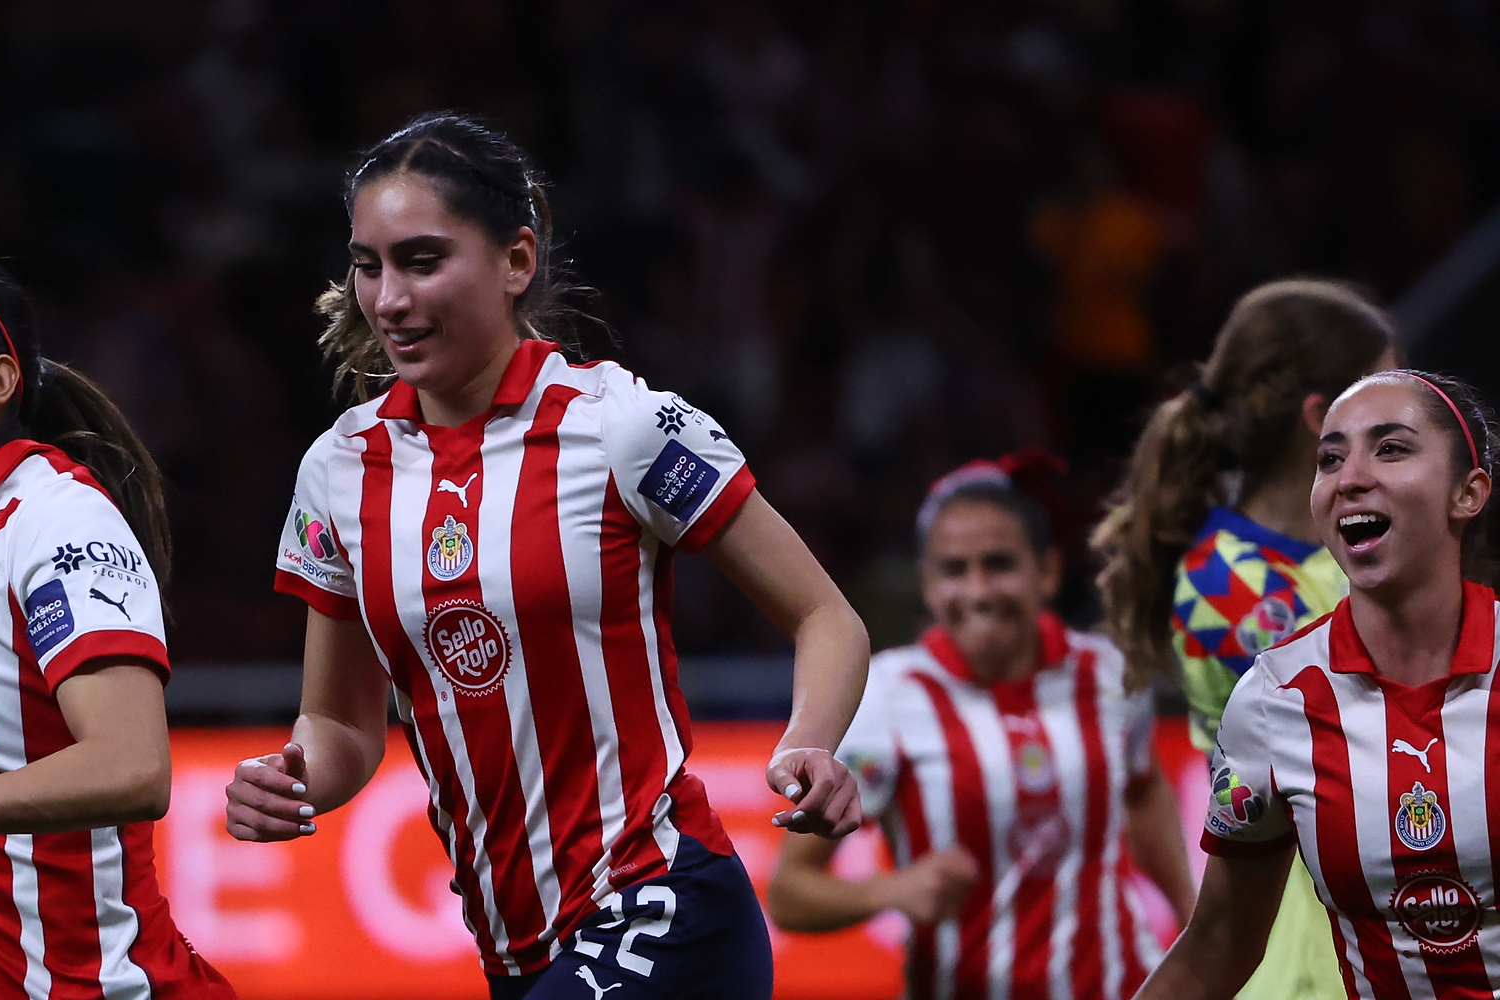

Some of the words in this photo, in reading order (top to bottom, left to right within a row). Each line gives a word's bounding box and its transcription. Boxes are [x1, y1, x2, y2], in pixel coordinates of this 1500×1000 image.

[656, 455, 687, 497] CLÁSICO
[663, 461, 697, 504] MÉXICO
[86, 541, 142, 573] GNP
[92, 567, 148, 590] SEGUROS
[29, 609, 65, 637] MÉXICO
[437, 617, 486, 657] Sello
